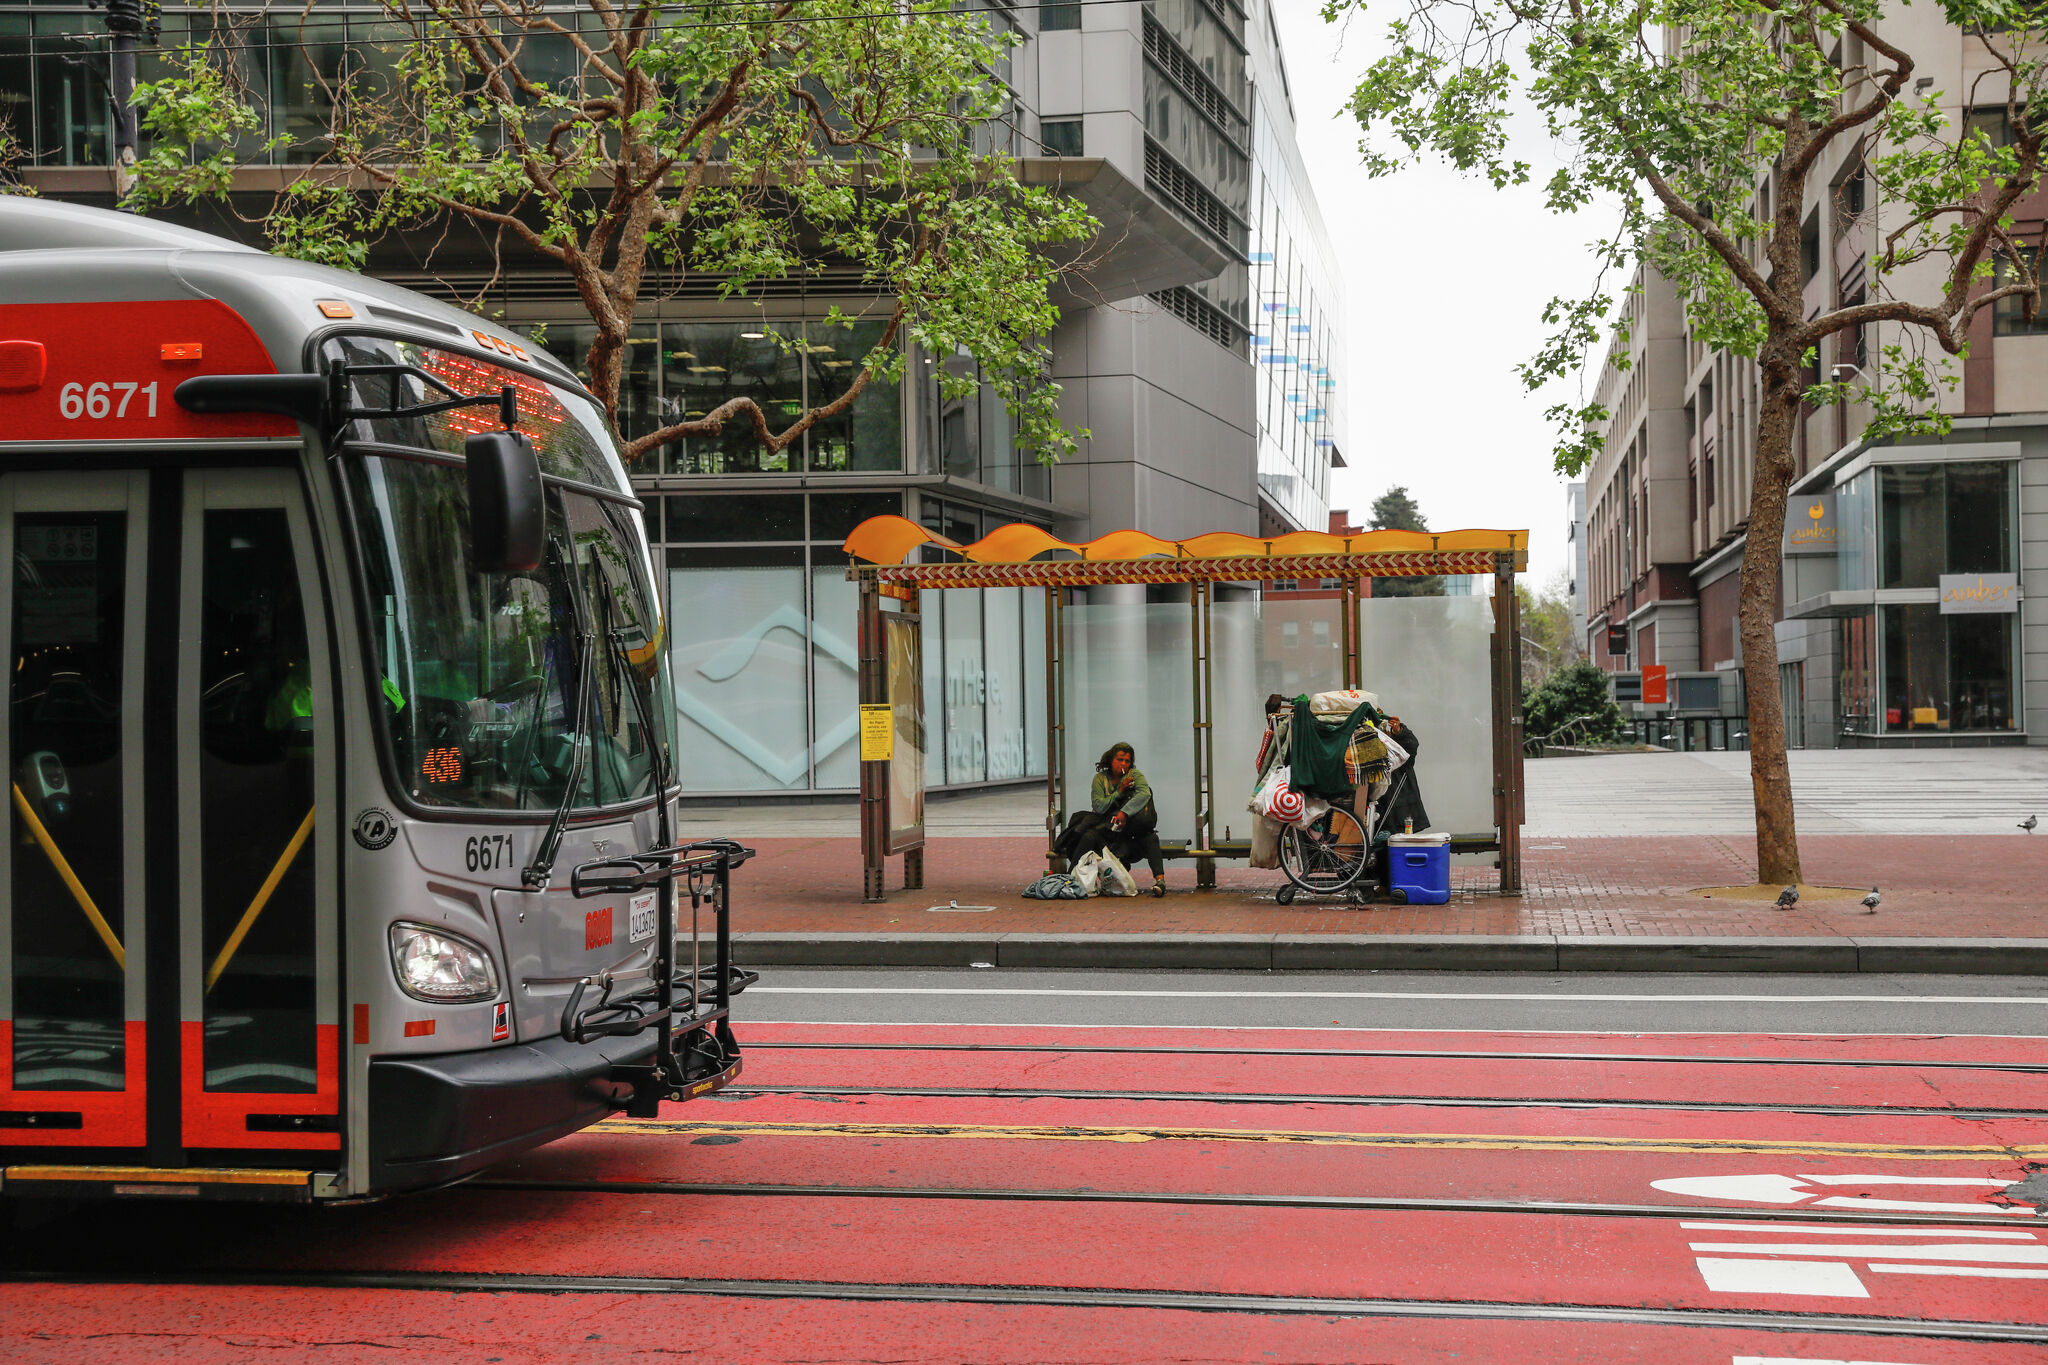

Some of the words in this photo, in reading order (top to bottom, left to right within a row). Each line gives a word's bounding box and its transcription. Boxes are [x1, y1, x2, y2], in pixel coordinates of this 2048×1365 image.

[60, 381, 158, 419] 6671
[1943, 577, 2014, 603] amber
[422, 747, 461, 783] 436
[465, 833, 513, 872] 6671
